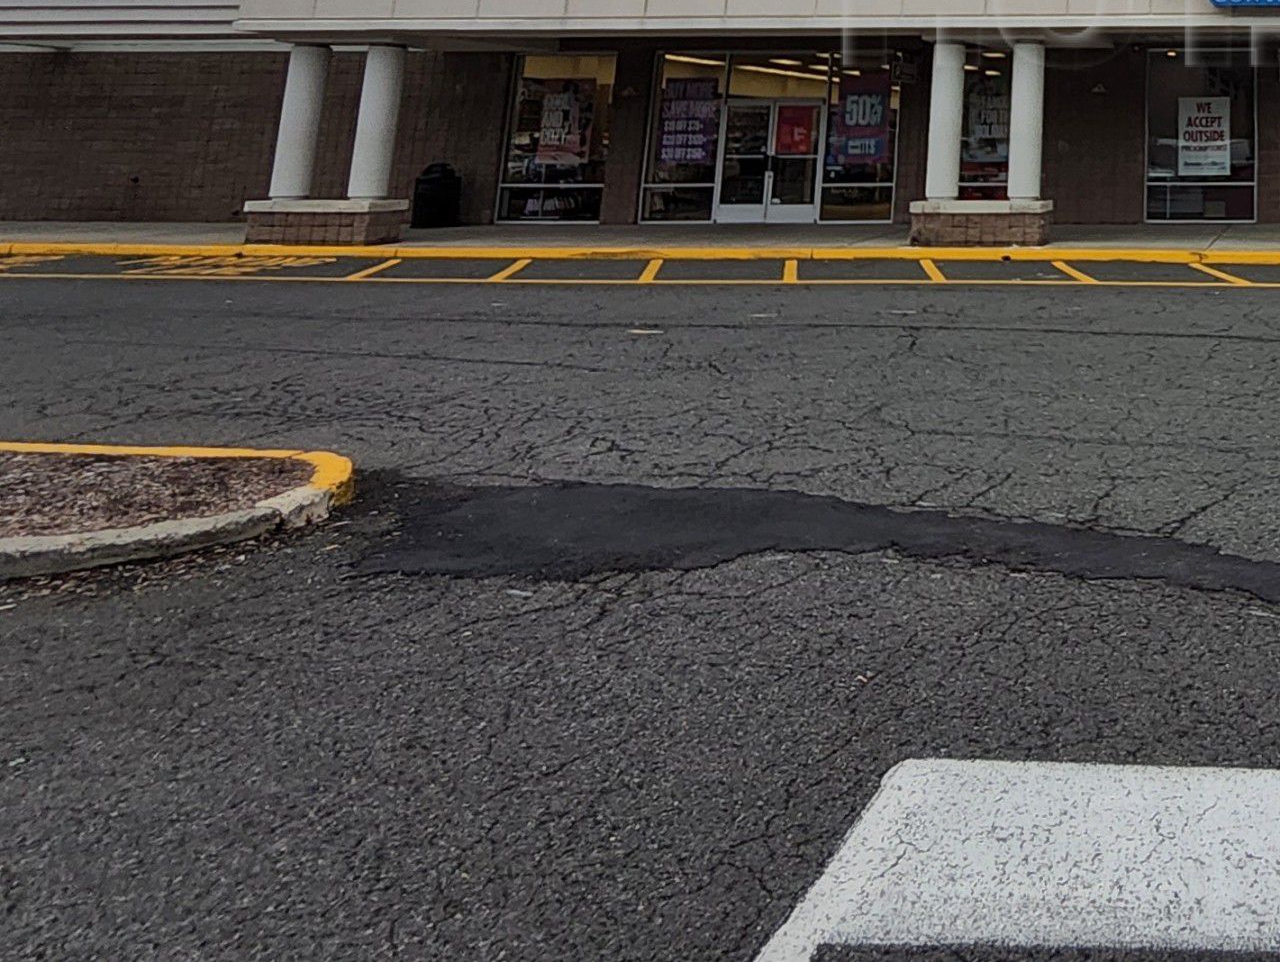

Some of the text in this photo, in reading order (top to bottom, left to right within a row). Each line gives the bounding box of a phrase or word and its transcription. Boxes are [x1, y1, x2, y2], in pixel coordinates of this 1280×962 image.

[1196, 102, 1212, 115] WE
[1186, 116, 1222, 129] ACCEPT
[1183, 130, 1225, 143] OUTSIDE
